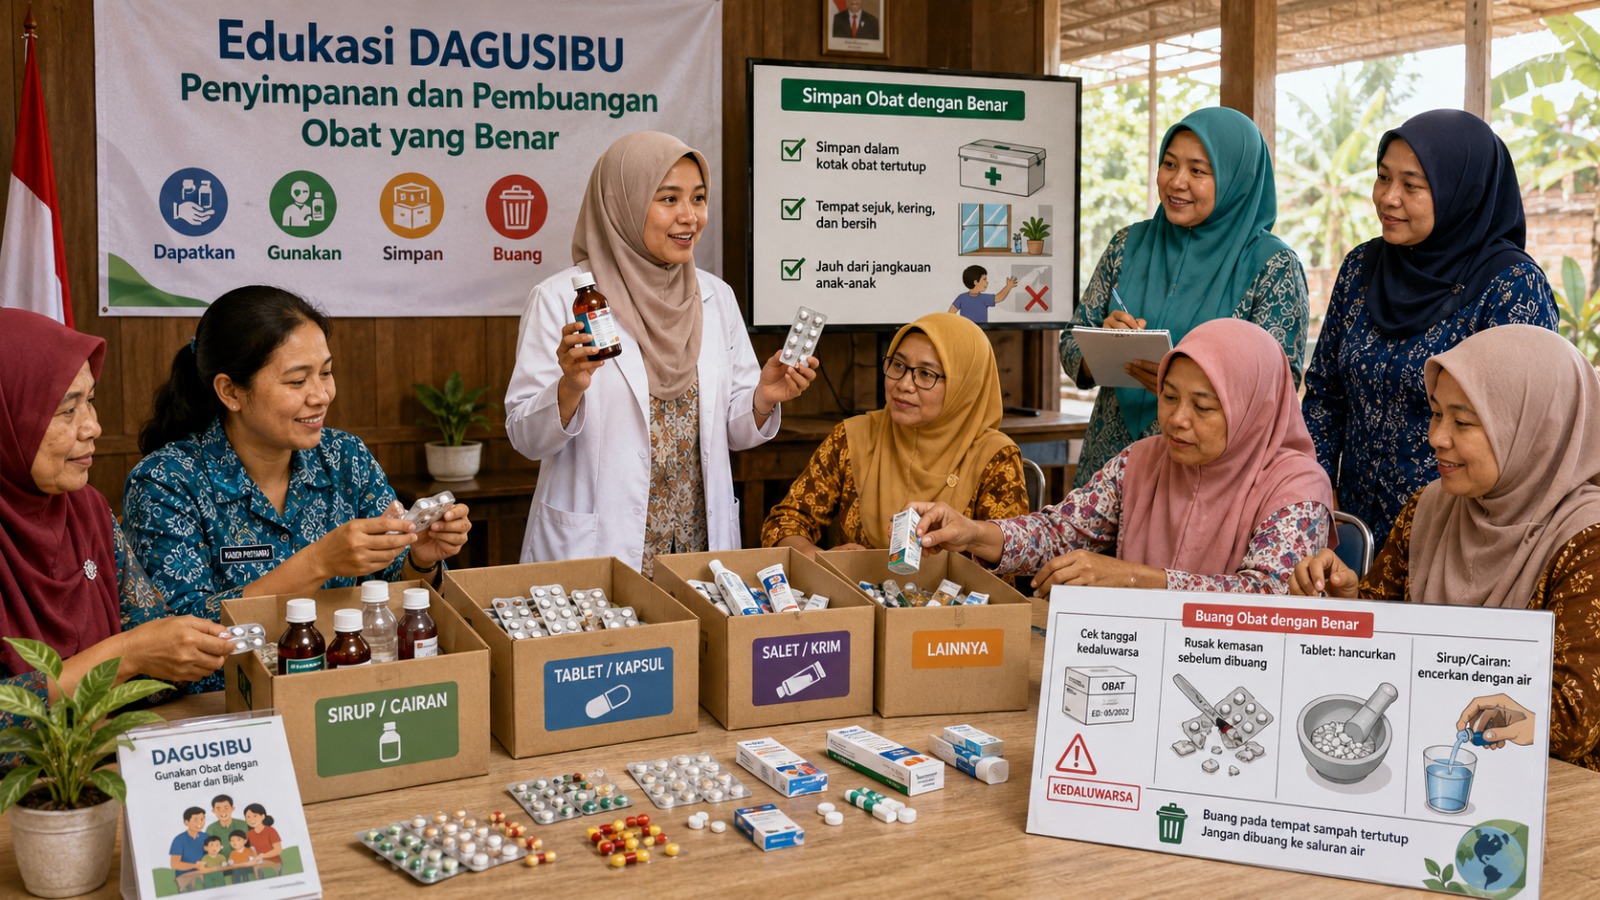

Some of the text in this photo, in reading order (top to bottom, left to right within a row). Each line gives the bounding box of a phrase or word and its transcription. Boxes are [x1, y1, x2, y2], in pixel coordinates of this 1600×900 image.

[219, 19, 623, 73] Edukasi DAGUSIBU
[181, 73, 658, 119] Penyimpanan dan Pembuangan
[803, 87, 1008, 113] Simpan Obat dengan Benar
[302, 118, 560, 156] Obat yang Benar
[816, 141, 899, 156] Simpan dalam
[816, 157, 926, 175] kotak obat tertutup
[816, 200, 935, 217] Tempat sejuk, kering,
[816, 216, 877, 229] dan bersih
[154, 244, 235, 264] Dapatkan
[267, 244, 342, 260] Gunakan
[383, 245, 443, 265] Simpan
[494, 246, 542, 265] Buang
[816, 260, 931, 275] Jauh dari jangkauan
[816, 277, 876, 289] anak-anak
[1195, 609, 1359, 630] Buang Obat dengan Benar
[1080, 628, 1137, 644] Cek tanggal
[1185, 637, 1263, 652] Rusak kemasan
[762, 640, 840, 659] SALET / KRIM
[928, 641, 988, 656] LAINNYA
[1077, 642, 1139, 657] kedaluwarsa
[1300, 644, 1396, 660] Tablet: hancurkan
[1178, 652, 1267, 671] sebelum dibuang
[1436, 652, 1511, 667] Sirup/Cairan:
[554, 657, 665, 683] TABLET / KAPSUL
[1418, 669, 1532, 686] encerkan dengan air
[1101, 681, 1126, 691] OBAT
[328, 692, 447, 723] SIRUP / CAIRAN
[151, 737, 252, 766] DAGUSIBU
[154, 760, 258, 781] Gunakan Obat dengan
[174, 773, 244, 791] Benar dan Bijak
[1053, 783, 1133, 803] KEDALUWARSA
[1203, 809, 1409, 847] Buang pada tempat sampah tertutup
[1201, 826, 1365, 856] Jangan dibuang ke saluran air
